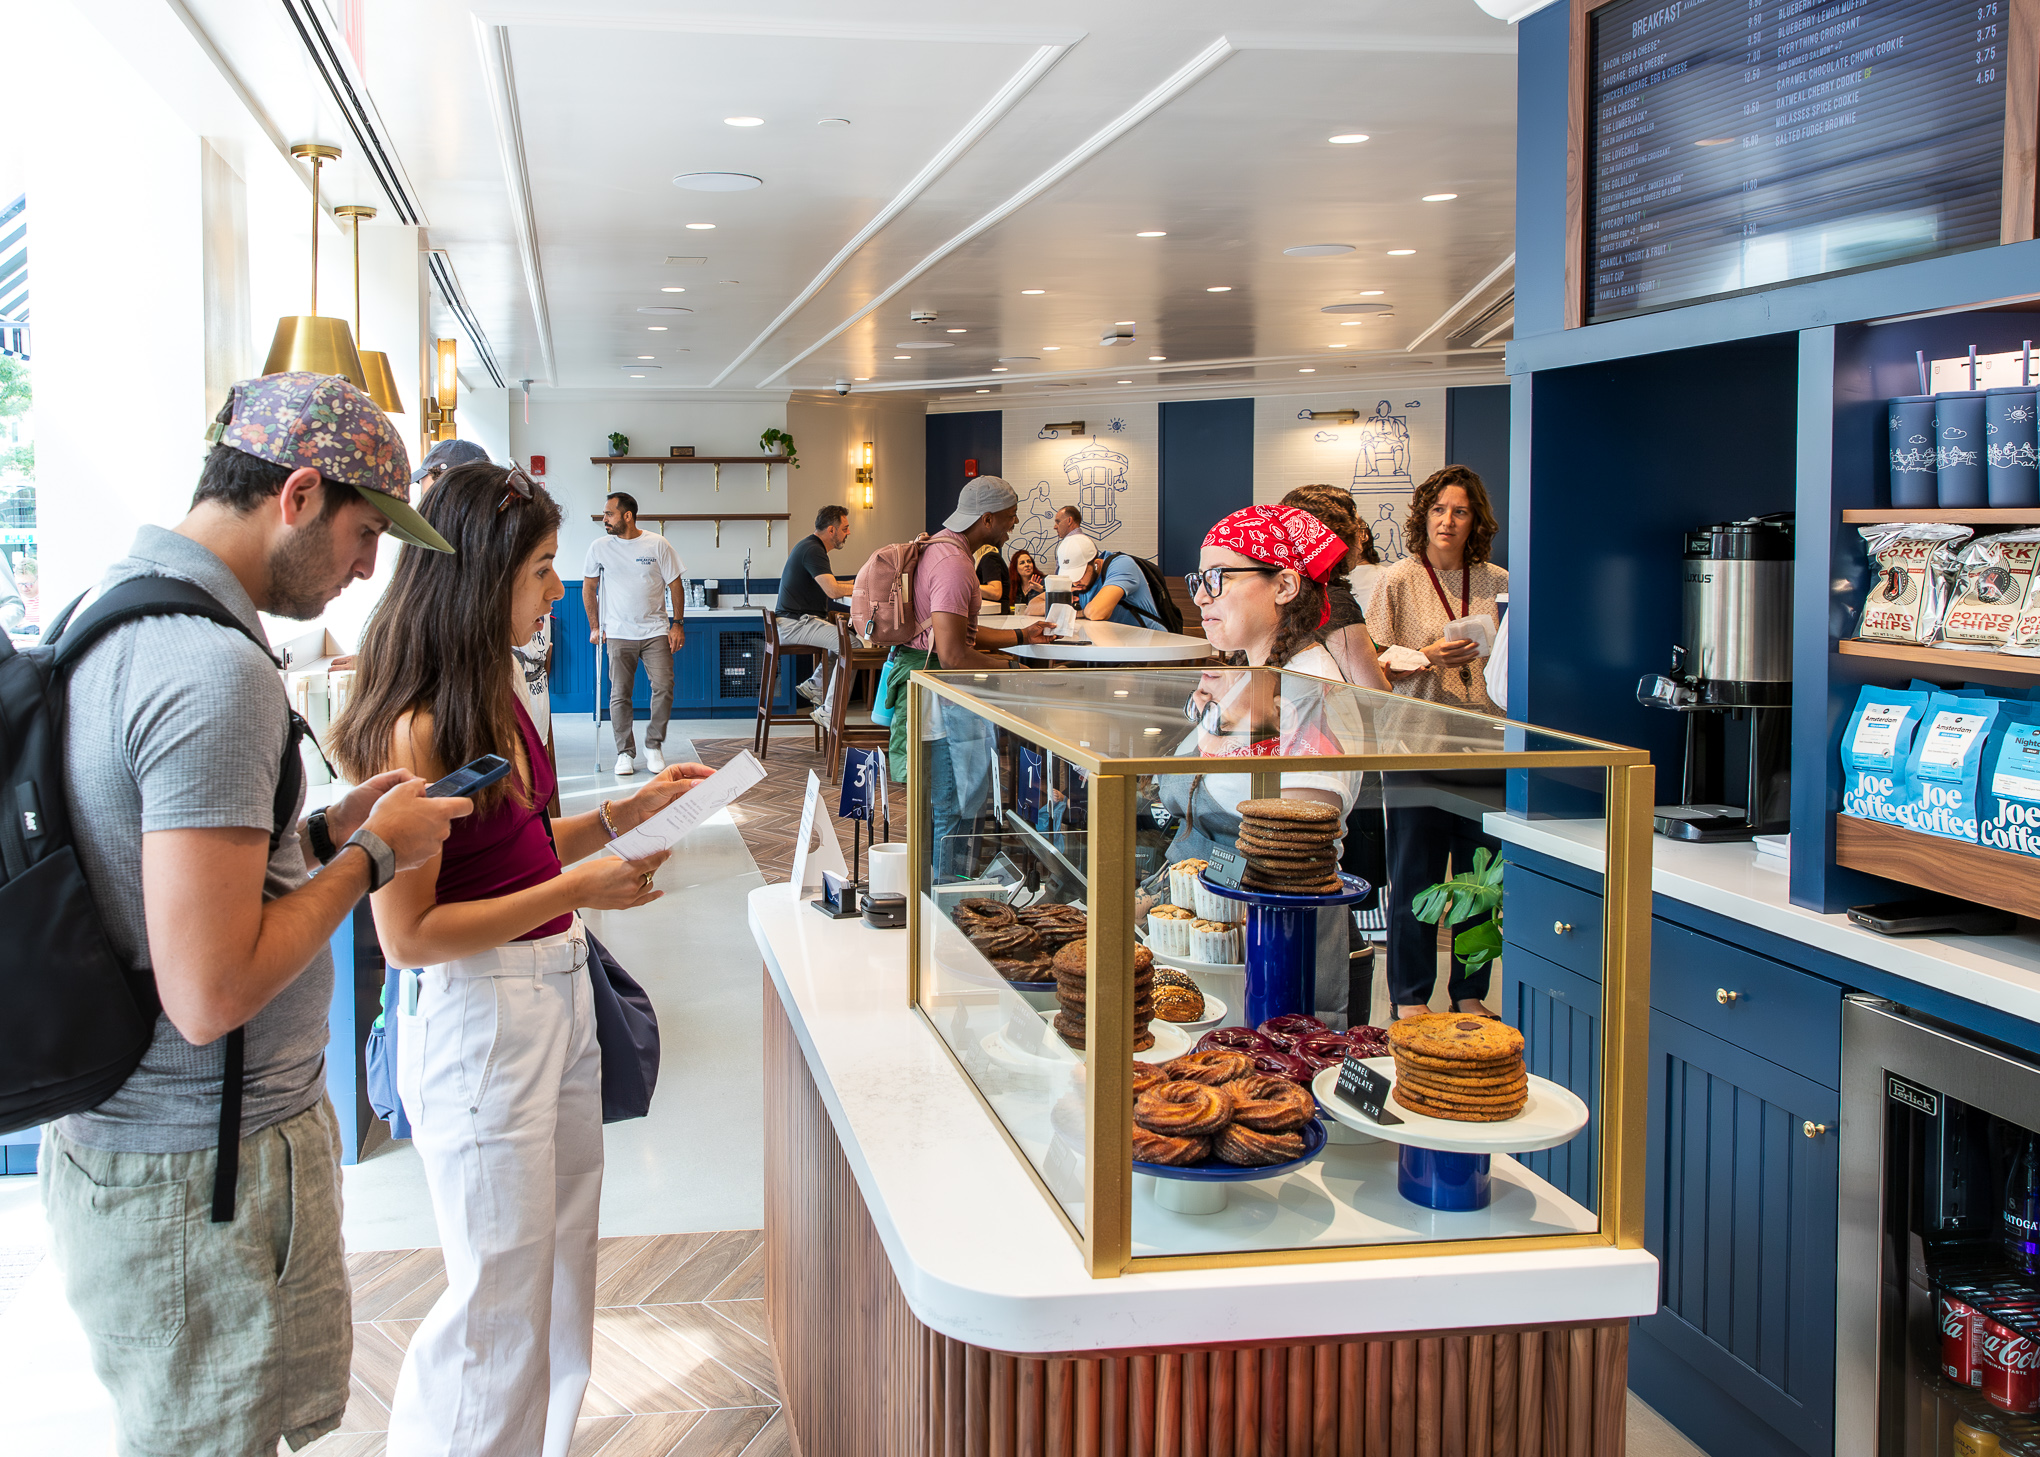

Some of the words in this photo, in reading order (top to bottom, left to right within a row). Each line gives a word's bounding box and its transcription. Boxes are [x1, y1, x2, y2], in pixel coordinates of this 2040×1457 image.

[1632, 1, 1682, 38] BREAKFAST
[1748, 13, 1762, 28] 9.50
[1977, 2, 1998, 21] 3.75
[1778, 14, 1816, 39] BLUEBERRY
[1817, 6, 1840, 24] LEMON
[1747, 31, 1761, 46] 9.50
[1777, 33, 1819, 58] EVERYTHING
[1820, 16, 1861, 42] CROISSANT
[1976, 24, 1997, 43] 3.75
[1622, 51, 1632, 64] EGG
[1632, 50, 1637, 59] &
[1746, 50, 1761, 65] 7.00
[1776, 69, 1807, 91] CARAMEL
[1808, 55, 1849, 80] CHOCOLATE
[1850, 46, 1875, 66] CHUNK
[1876, 36, 1904, 56] COOKIE
[1777, 64, 1787, 72] ADD
[1788, 53, 1809, 68] SMOKED
[1976, 46, 1996, 65] 3.75
[1628, 66, 1638, 77] EGG
[1639, 62, 1644, 73] &
[1744, 68, 1761, 83] 12.50
[1976, 68, 1996, 85] 4.50
[1602, 88, 1624, 104] CHICKEN
[1650, 73, 1660, 85] EGG
[1661, 70, 1666, 80] &
[1666, 61, 1688, 78] CHEESE
[1776, 88, 1807, 109] OATMEAL
[1807, 78, 1835, 99] CHERRY
[1836, 70, 1862, 90] COOKIE
[1864, 67, 1873, 79] GF
[1602, 108, 1612, 120] EGG
[1613, 106, 1617, 115] &
[1743, 101, 1760, 116] 13.50
[1775, 107, 1810, 128] MOLASSES
[1811, 99, 1832, 116] SPICE
[1833, 91, 1860, 110] COOKIE
[1602, 124, 1612, 135] THE
[1775, 128, 1801, 147] SALTED
[1802, 121, 1824, 139] FUDGE
[1824, 111, 1857, 131] BROWNIE
[1742, 134, 1759, 149] 15.00
[1602, 153, 1611, 164] THE
[1612, 142, 1639, 161] LOVECHILD
[1623, 155, 1647, 170] EVERYTHING
[1647, 146, 1671, 161] CROISSANT
[1601, 181, 1610, 192] THE
[1648, 180, 1664, 191] SMOKED
[1742, 178, 1758, 192] 11.00
[1622, 200, 1630, 208] RED
[1662, 188, 1668, 197] OF
[1667, 184, 1682, 195] LEMON
[1600, 216, 1624, 231] AVOCADO
[1624, 211, 1641, 224] TOAST
[1624, 250, 1644, 263] YOGURT
[1645, 249, 1650, 259] &
[1650, 244, 1668, 257] FRUIT
[1600, 274, 1614, 286] FRUIT
[1614, 270, 1625, 282] CUP
[1600, 287, 1620, 300] VANILLA
[1620, 284, 1636, 296] BEAN
[1636, 280, 1656, 294] YOGURT
[1878, 548, 1928, 562] FORK
[1864, 618, 1912, 631] CHIPS
[1865, 610, 1914, 622] POTATO
[1951, 612, 2014, 623] POTATO
[1949, 620, 2011, 632] CHIPS
[1865, 715, 1898, 724] Amsterdam
[1936, 724, 1972, 734] Amsterdam
[2014, 737, 2040, 748] Nightc
[854, 764, 867, 788] 3
[1027, 766, 1033, 788] 1
[1854, 771, 1894, 798] Joe
[1918, 782, 1963, 810] Joe
[1843, 791, 1910, 823] Coffee
[1993, 798, 2040, 828] Joe
[24, 812, 38, 830] Aer
[1907, 803, 1978, 839] Coffee
[1980, 820, 2040, 856] Coffe
[1212, 848, 1234, 862] MOLASSES
[1208, 860, 1222, 871] SPICE
[1226, 878, 1238, 888] 3.75
[1343, 1058, 1368, 1078] CARAMEL
[1338, 1076, 1356, 1093] CHUNK
[1340, 1066, 1374, 1092] CHOCOLATE
[1892, 1082, 1932, 1111] Perlick
[1363, 1102, 1380, 1116] 3.75
[2008, 1368, 2028, 1376] TASTE
